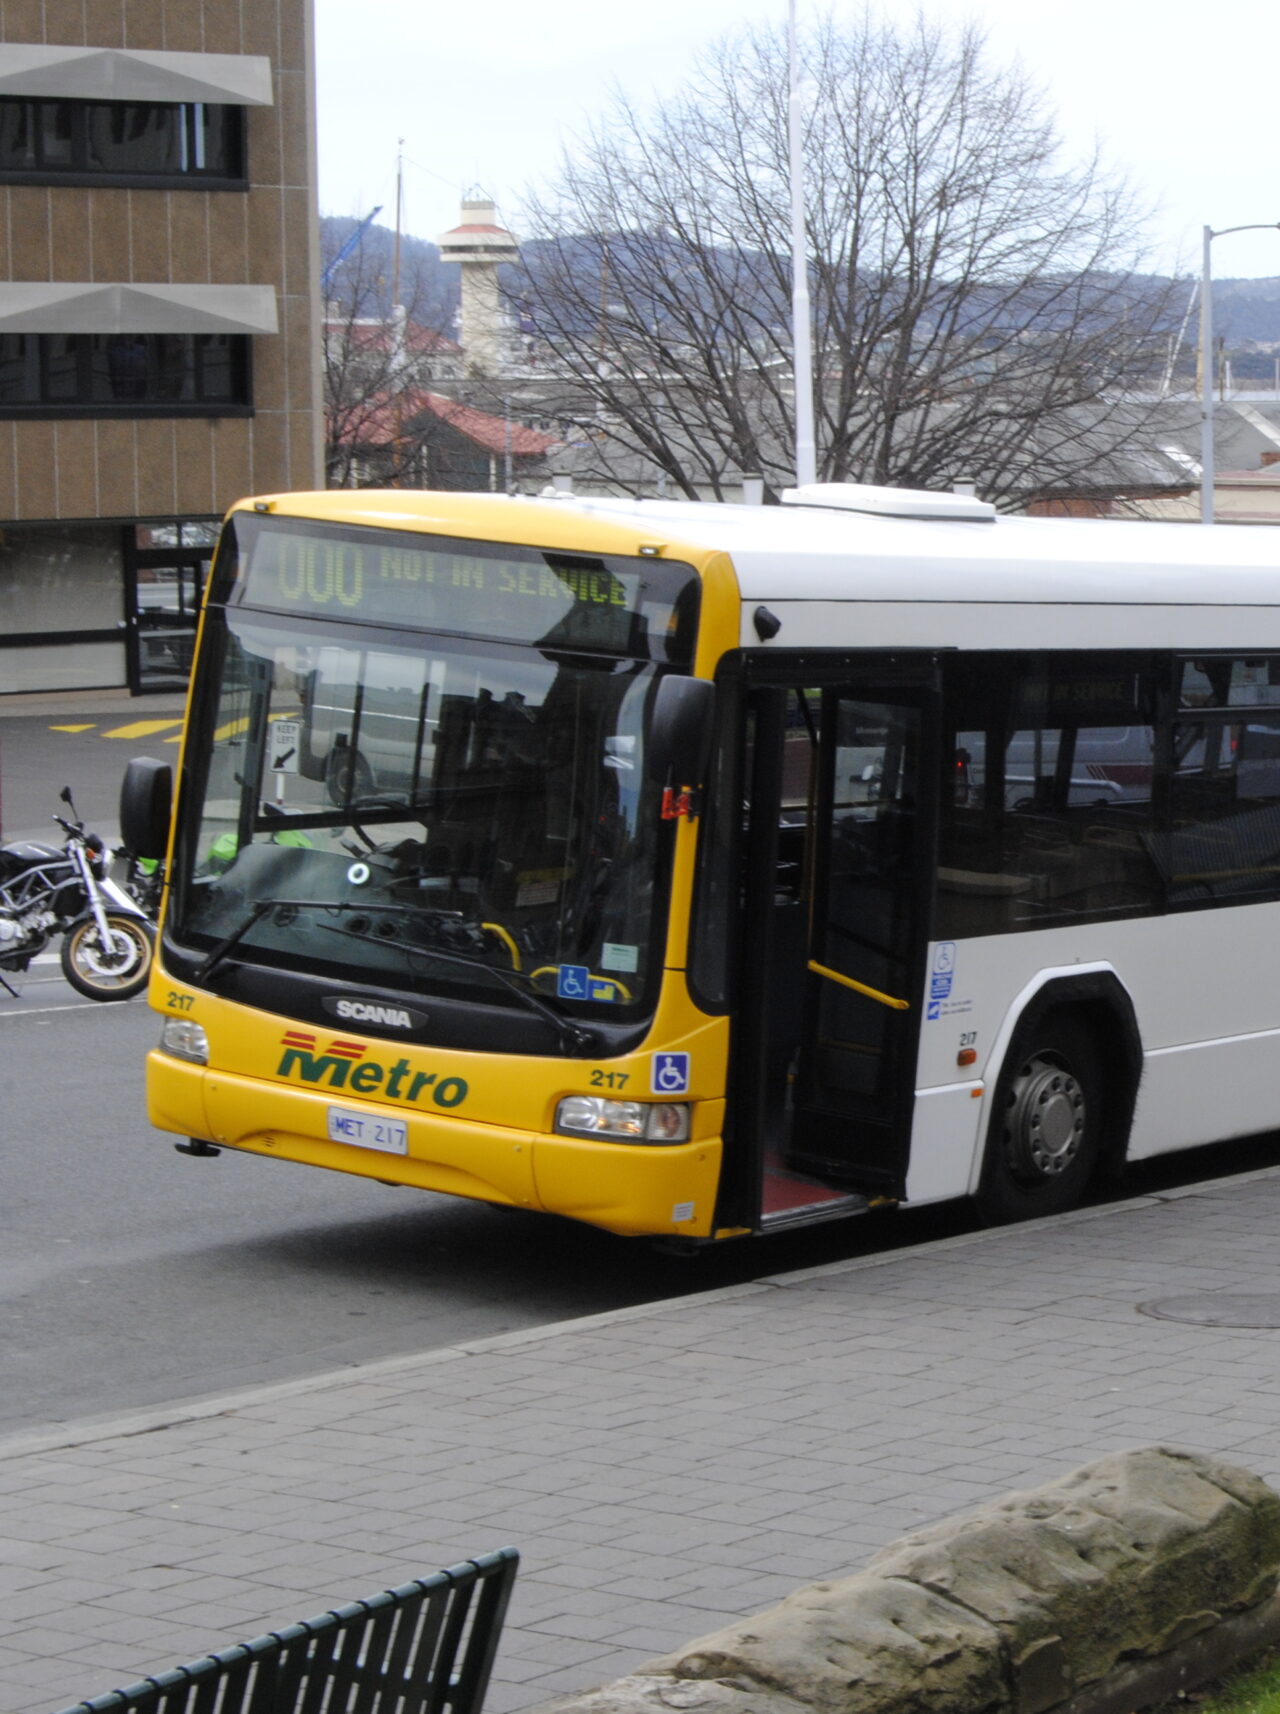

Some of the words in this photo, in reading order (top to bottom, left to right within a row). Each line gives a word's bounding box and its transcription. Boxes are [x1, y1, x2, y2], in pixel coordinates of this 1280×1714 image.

[380, 549, 435, 583] NOT
[452, 556, 484, 589] IN
[499, 563, 629, 606] SERVICE
[276, 735, 294, 744] LEFT
[277, 725, 297, 734] KEEP
[166, 992, 195, 1011] 217
[336, 1000, 412, 1028] SCANIA
[959, 1031, 978, 1047] 217
[276, 1030, 469, 1108] Metro
[590, 1069, 630, 1090] 217
[335, 1116, 365, 1138] MET
[374, 1124, 406, 1147] 217
